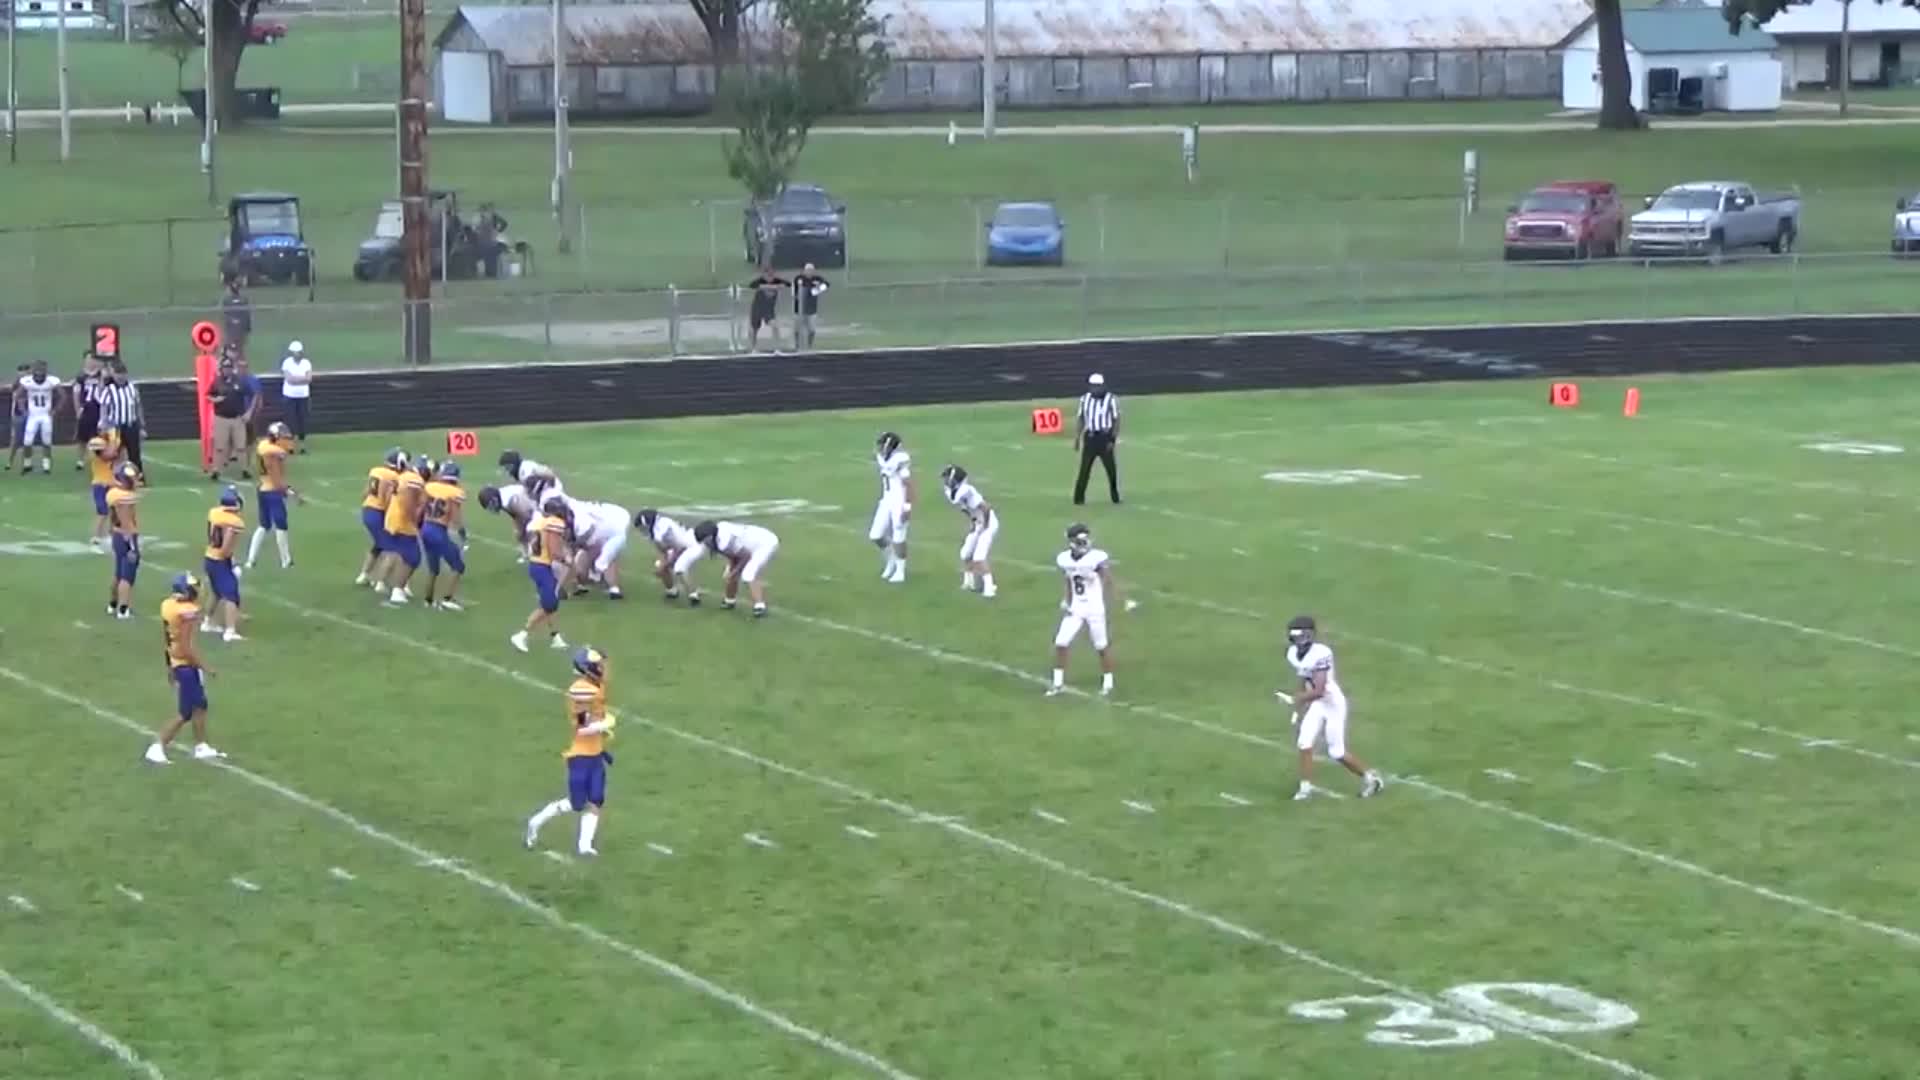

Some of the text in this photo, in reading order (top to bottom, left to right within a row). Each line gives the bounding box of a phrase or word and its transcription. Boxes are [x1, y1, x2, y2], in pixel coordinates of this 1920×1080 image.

[1038, 411, 1059, 428] 10
[454, 433, 475, 450] 20
[1287, 981, 1640, 1047] 30
